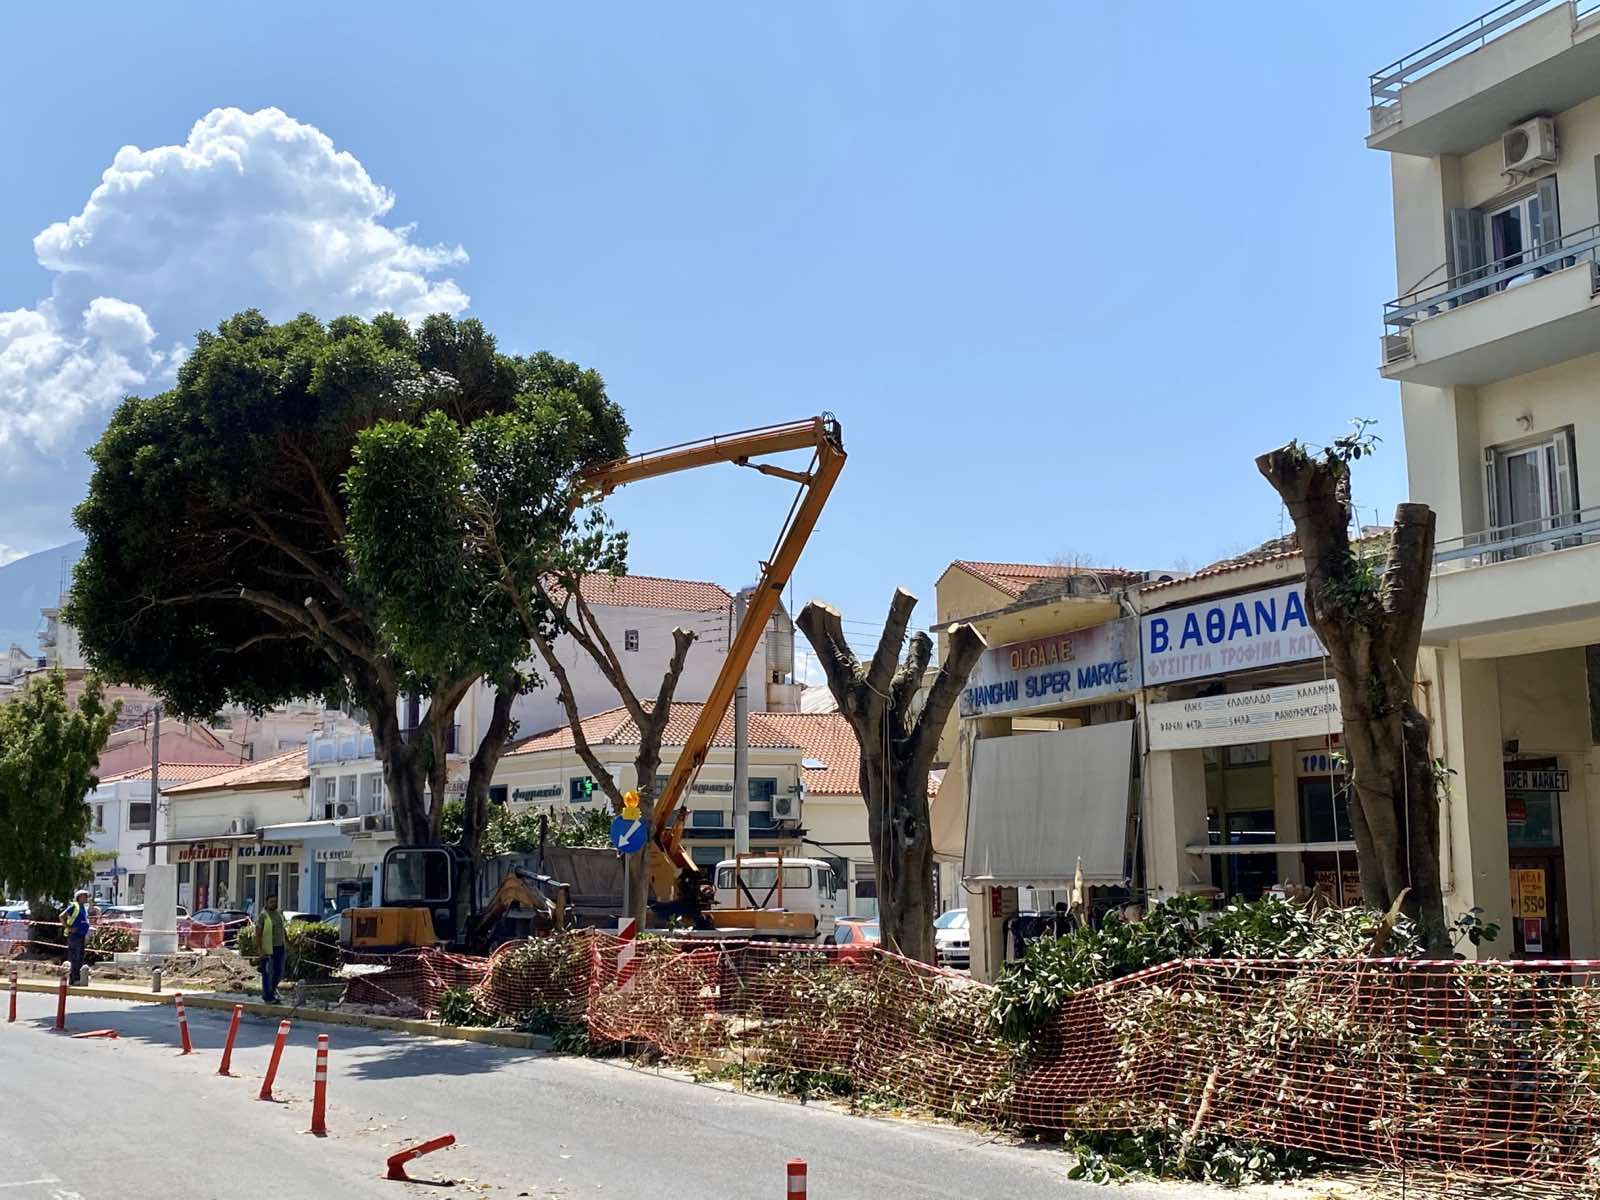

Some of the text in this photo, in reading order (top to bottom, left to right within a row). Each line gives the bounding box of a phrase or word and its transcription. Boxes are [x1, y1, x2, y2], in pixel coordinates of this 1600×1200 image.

[1179, 591, 1308, 649] ΑΘΑΝΑ
[1148, 635, 1318, 677] ΦΥΣΙΓΓΙΑ ΤΡΟΦΙΜΑ ΚΑΤ
[1025, 670, 1071, 698] SUPER
[1077, 660, 1130, 690] MARKE
[1505, 771, 1567, 789] UPER MARKET
